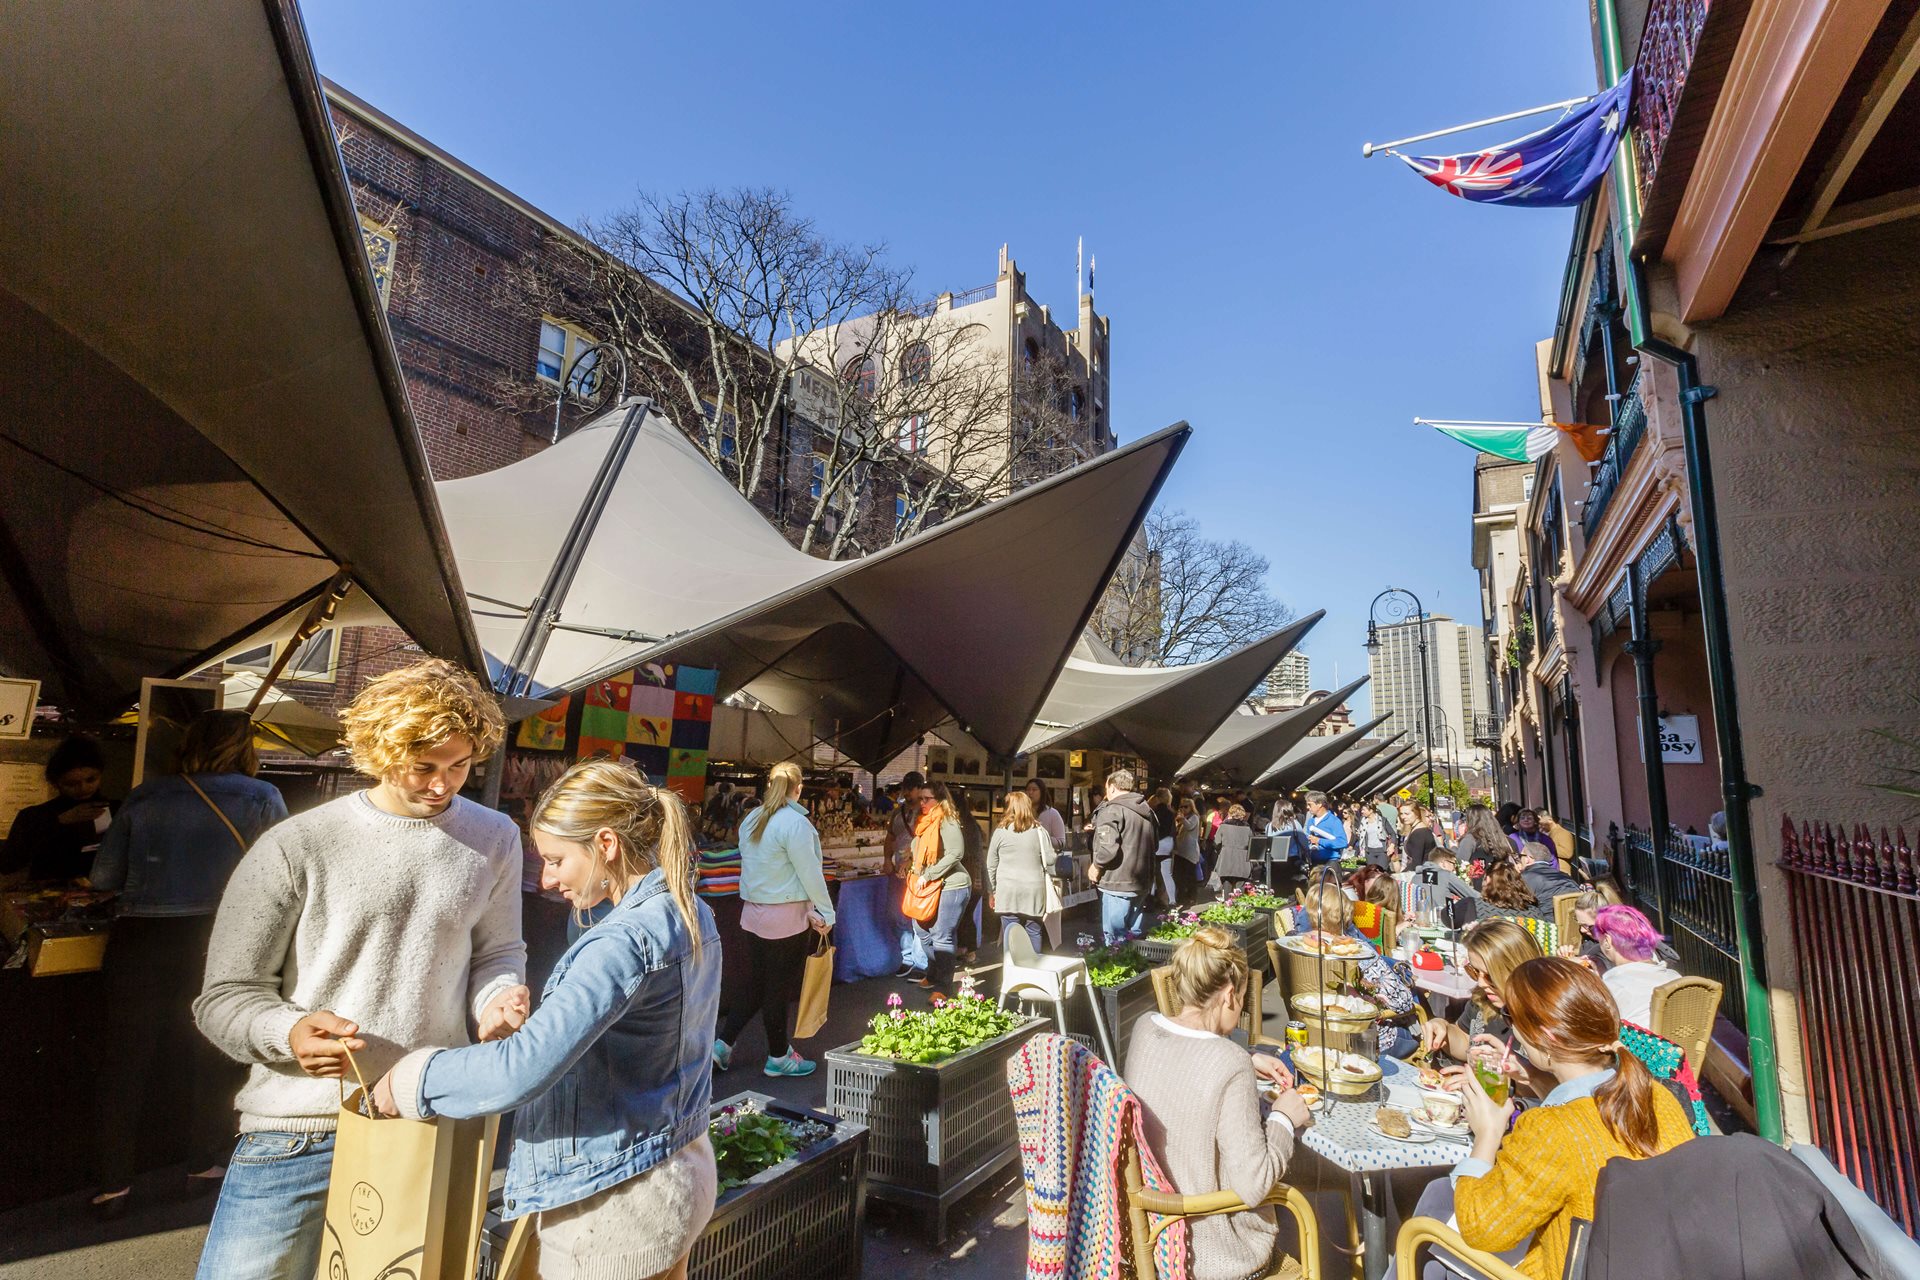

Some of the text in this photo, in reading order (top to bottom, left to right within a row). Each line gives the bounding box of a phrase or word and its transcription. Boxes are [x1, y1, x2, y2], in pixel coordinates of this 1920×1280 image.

[1659, 733, 1680, 743] ea
[1660, 738, 1696, 755] osy
[1426, 872, 1434, 883] 7
[358, 1187, 371, 1198] THE
[353, 1212, 375, 1230] ROCKS
